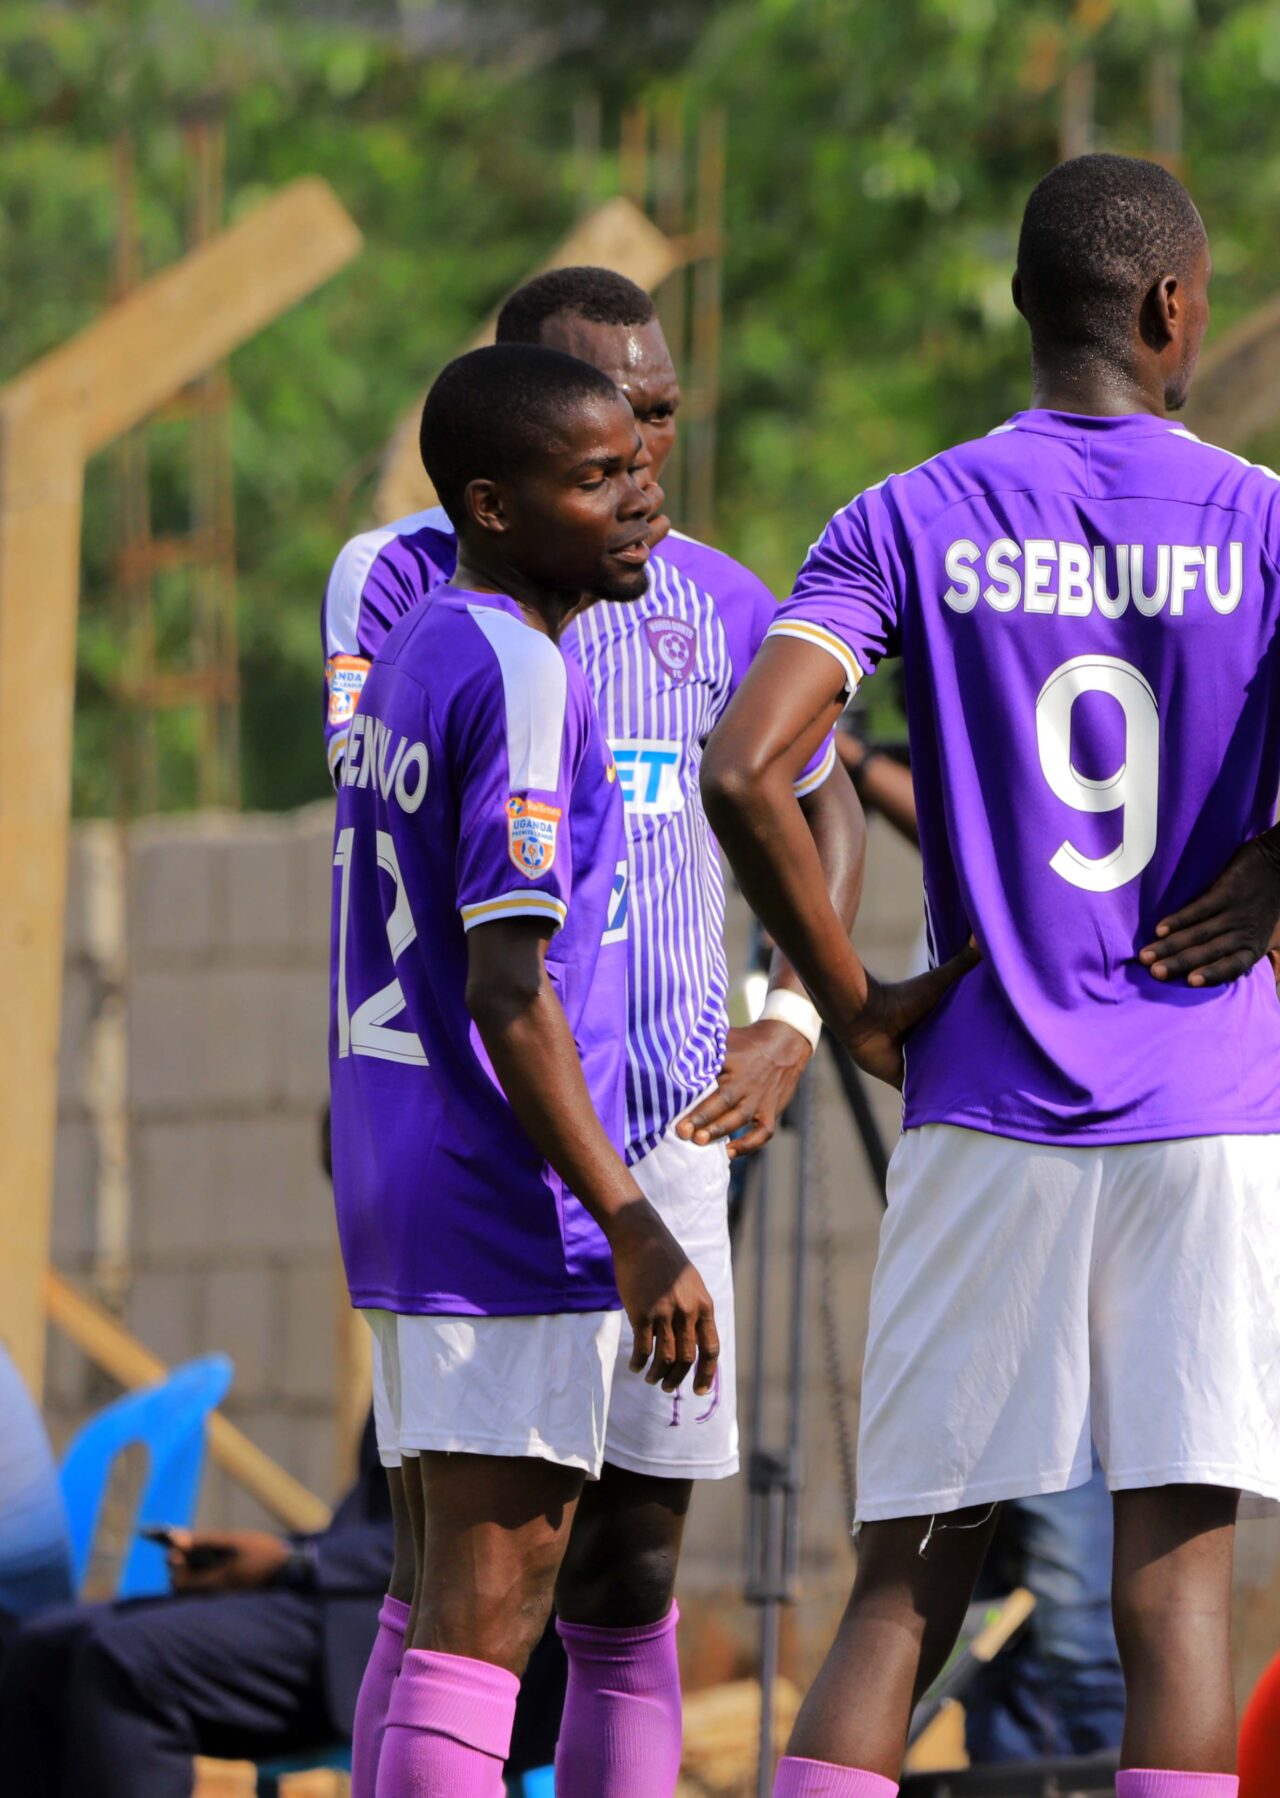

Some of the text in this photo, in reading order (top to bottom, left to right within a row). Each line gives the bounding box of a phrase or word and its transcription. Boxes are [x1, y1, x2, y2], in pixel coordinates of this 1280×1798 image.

[943, 538, 1244, 619] SSEBUUFU
[513, 818, 554, 834] UGANDA
[1035, 653, 1160, 893] 9
[333, 827, 431, 1067] 12
